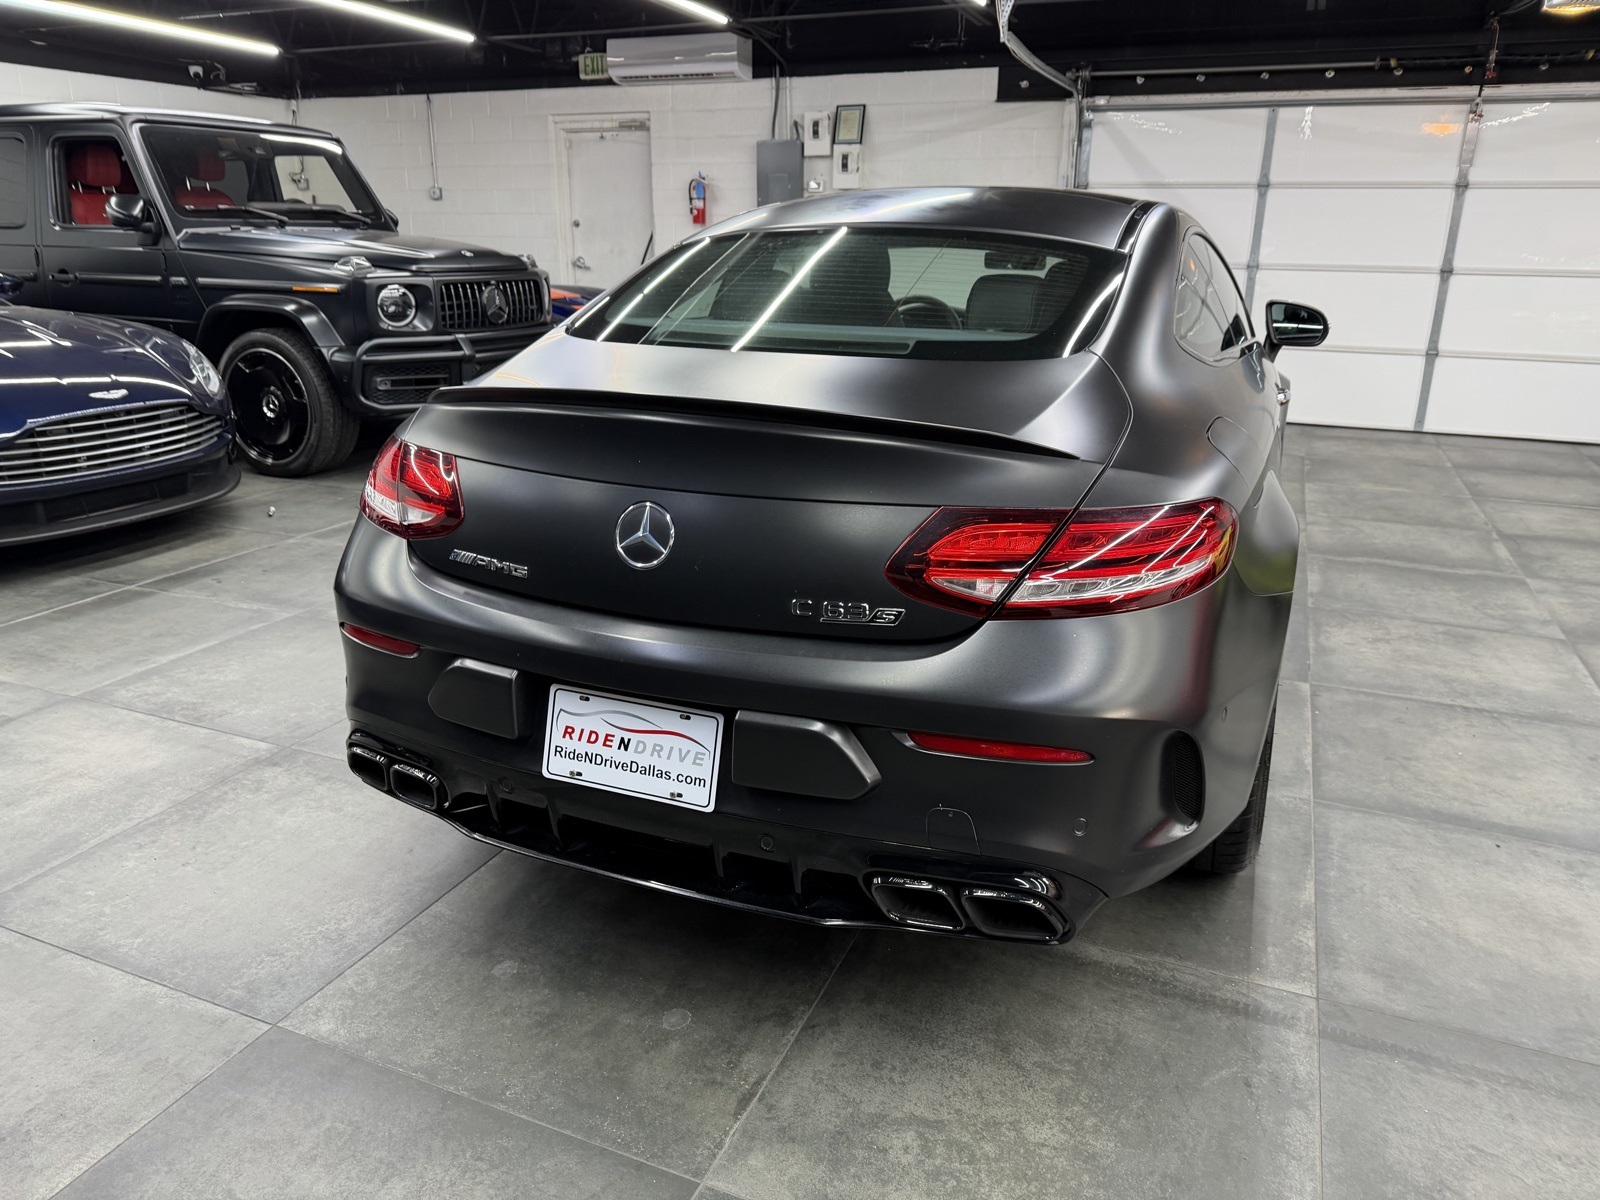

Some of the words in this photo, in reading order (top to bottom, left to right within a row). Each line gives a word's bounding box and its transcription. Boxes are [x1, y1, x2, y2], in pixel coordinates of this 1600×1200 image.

[583, 55, 605, 76] EXIT
[471, 554, 528, 579] AMG
[791, 599, 813, 617] C
[822, 601, 870, 620] 63
[874, 610, 899, 623] S
[554, 745, 706, 788] RideNDriveDallas.com
